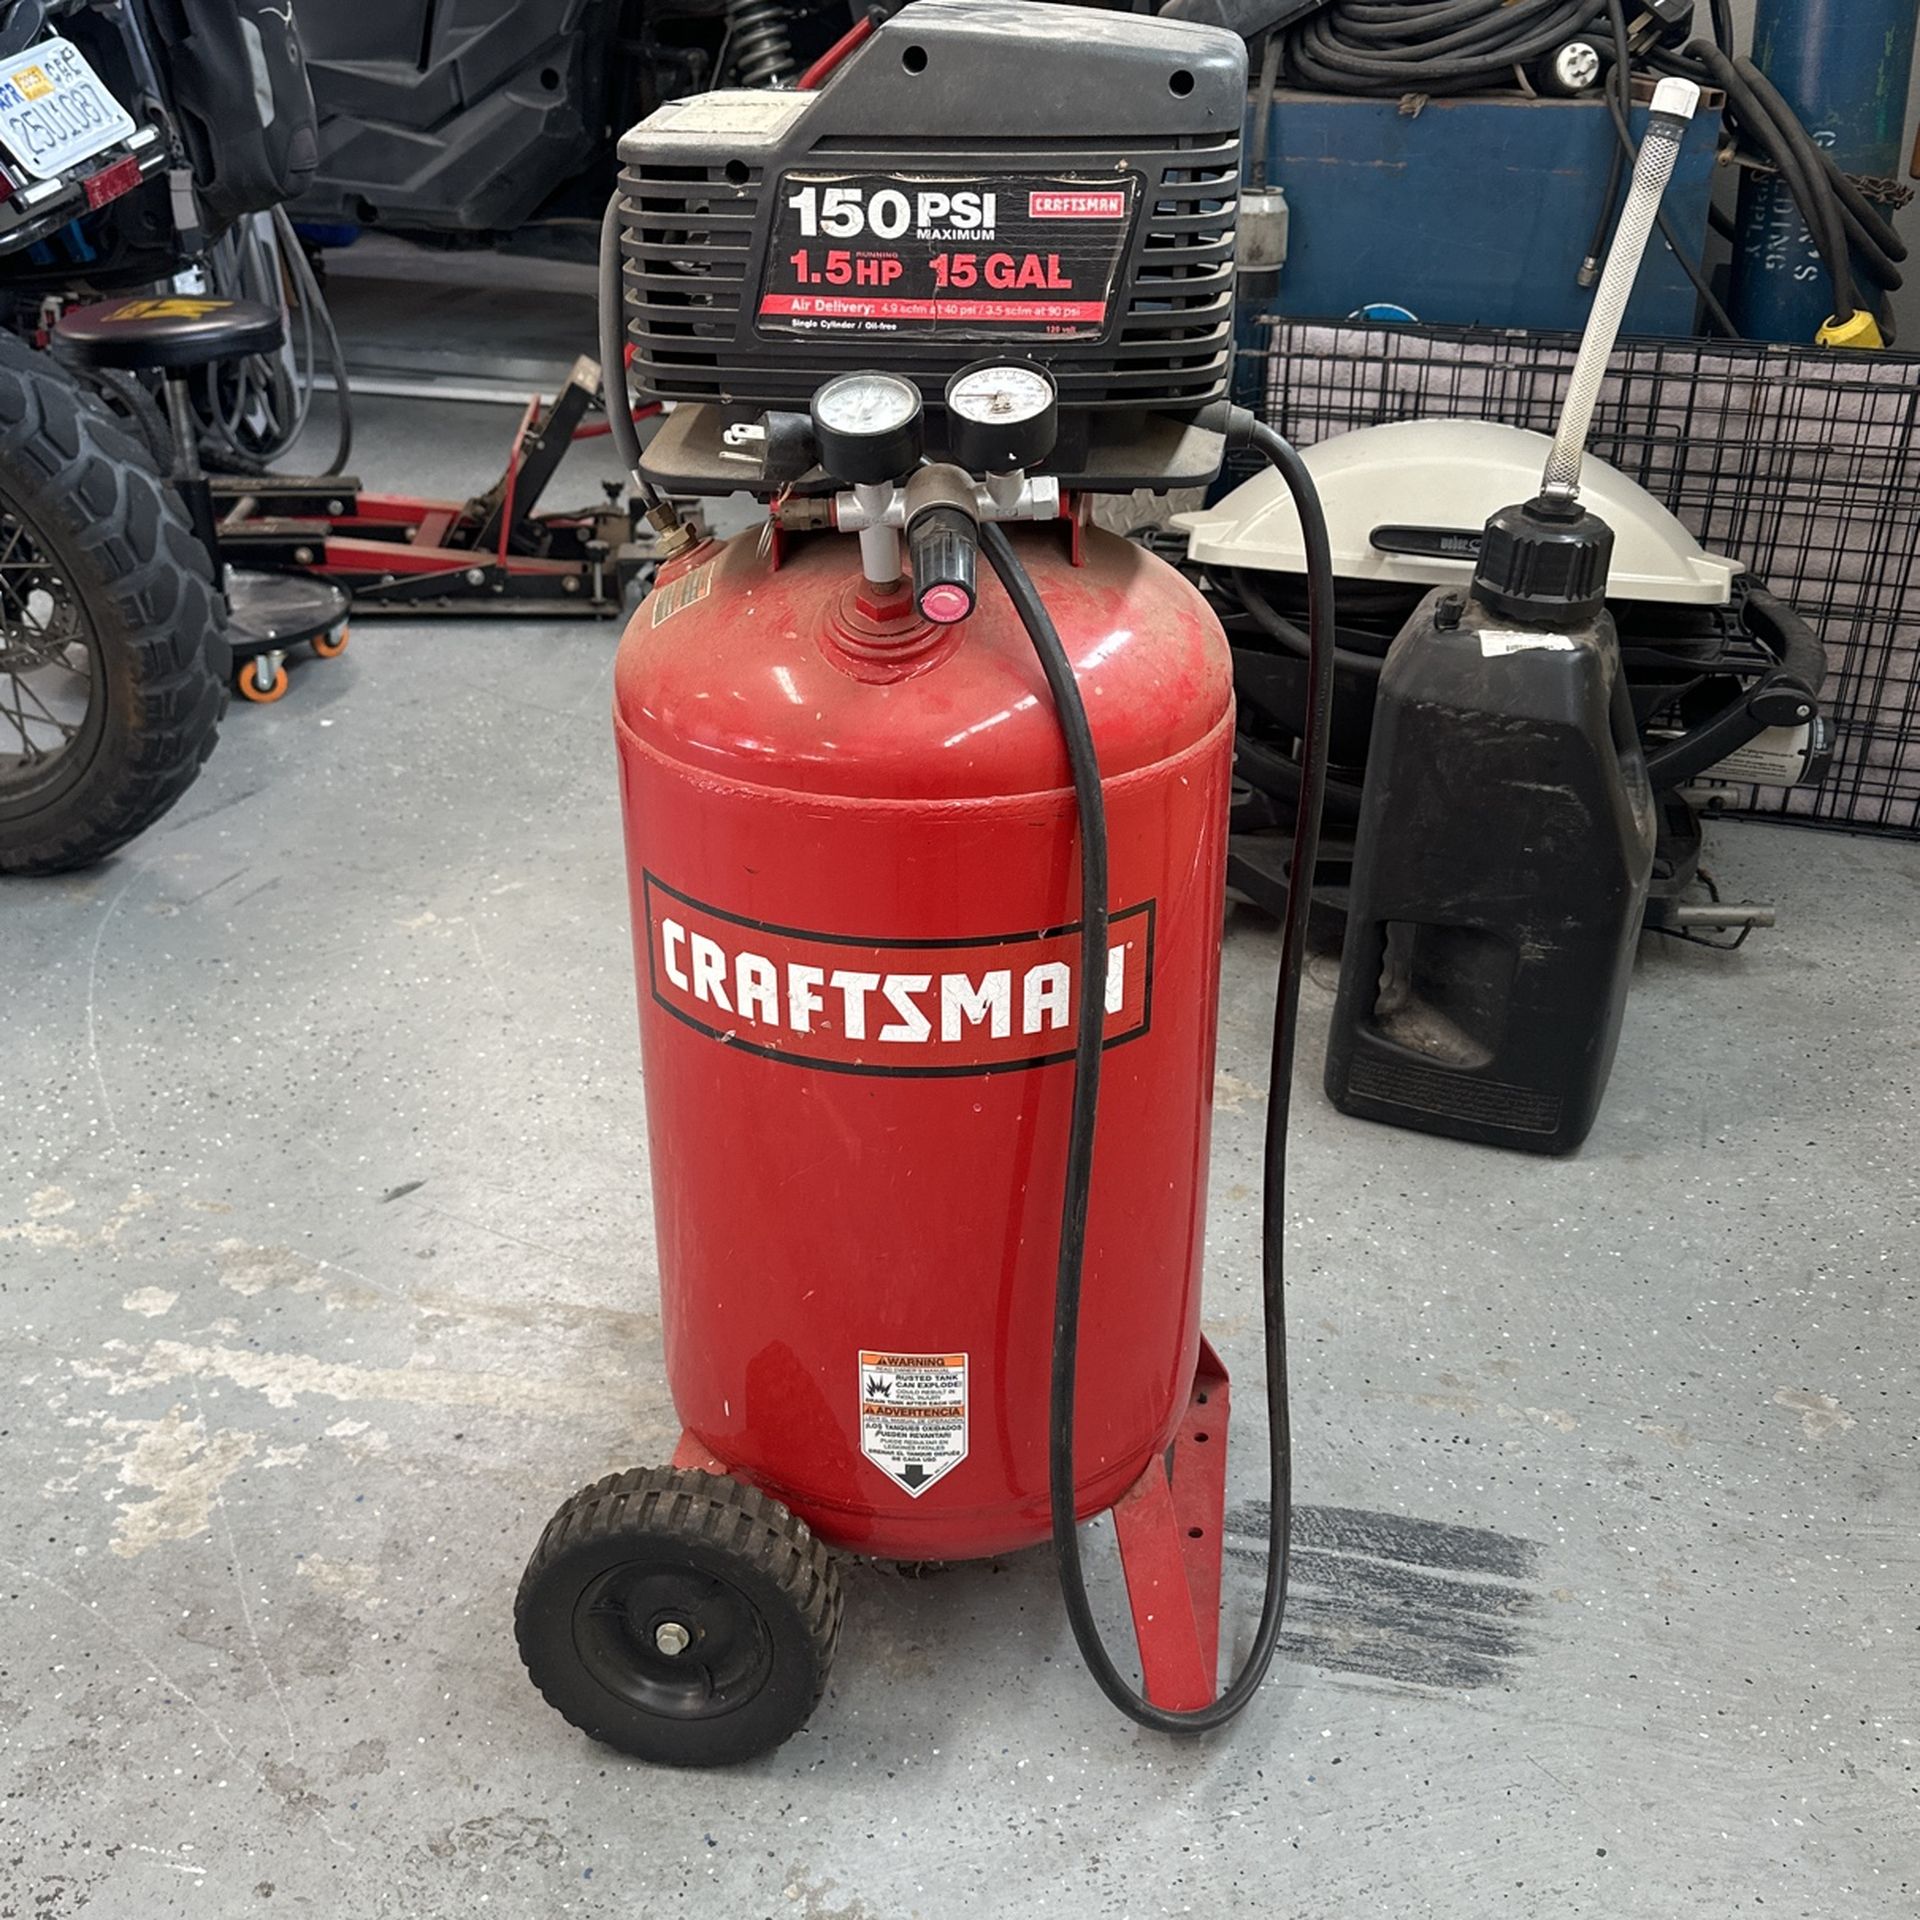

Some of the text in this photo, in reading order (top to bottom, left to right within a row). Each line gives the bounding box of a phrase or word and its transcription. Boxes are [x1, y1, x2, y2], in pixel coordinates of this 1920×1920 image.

[1035, 198, 1119, 213] CRAFTSMAN
[788, 186, 996, 239] 150 PSI
[916, 228, 995, 241] MAXIMUM
[855, 251, 899, 259] RUNNING
[928, 253, 978, 288] 15
[984, 252, 1073, 289] GAL
[790, 299, 812, 312] Air
[815, 299, 876, 316] Delivery:
[944, 305, 958, 314] 40
[960, 305, 977, 317] psi
[1005, 306, 1032, 316] scfm
[1034, 306, 1046, 315] at
[1047, 306, 1062, 317] 90
[1063, 307, 1081, 318] psi
[791, 319, 818, 329] Single
[820, 319, 856, 330] Cylinder
[864, 321, 898, 331] Oil-free
[887, 1356, 945, 1367] WARNING
[896, 1374, 933, 1382] RUSTED
[875, 1406, 961, 1417] ADVERTENCIA
[885, 1424, 921, 1432] TANQUES
